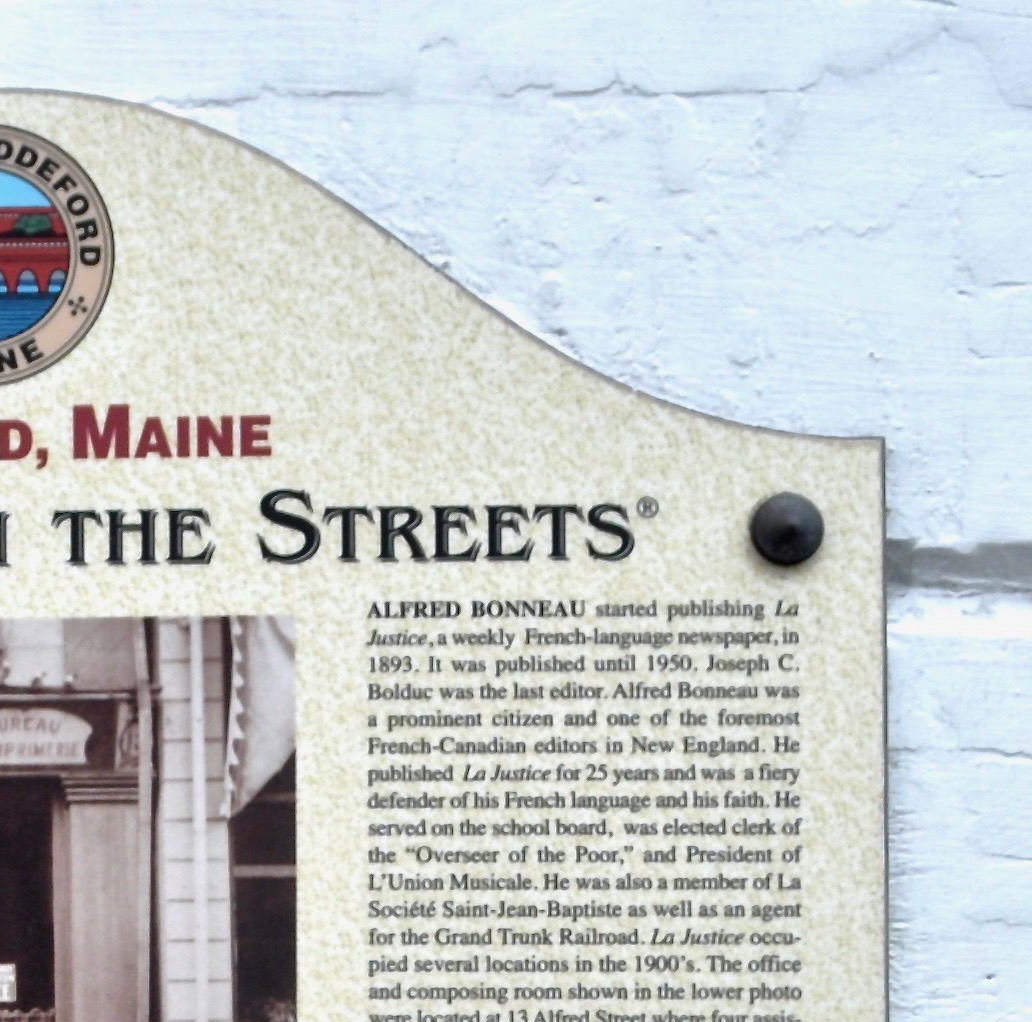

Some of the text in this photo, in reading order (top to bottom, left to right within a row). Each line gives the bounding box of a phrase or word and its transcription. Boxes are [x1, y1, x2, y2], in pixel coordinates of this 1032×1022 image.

[72, 403, 272, 461] MAINE
[51, 508, 216, 568] THE
[367, 599, 799, 622] ALFRED BONNEAU started publishing La
[370, 654, 799, 677] 1893. It was published until 1950. Joseph C.
[368, 681, 800, 701] Bolduc was the last editor. Alfred Bonneau was
[368, 708, 800, 732] a prominent citizen and one of the foremost
